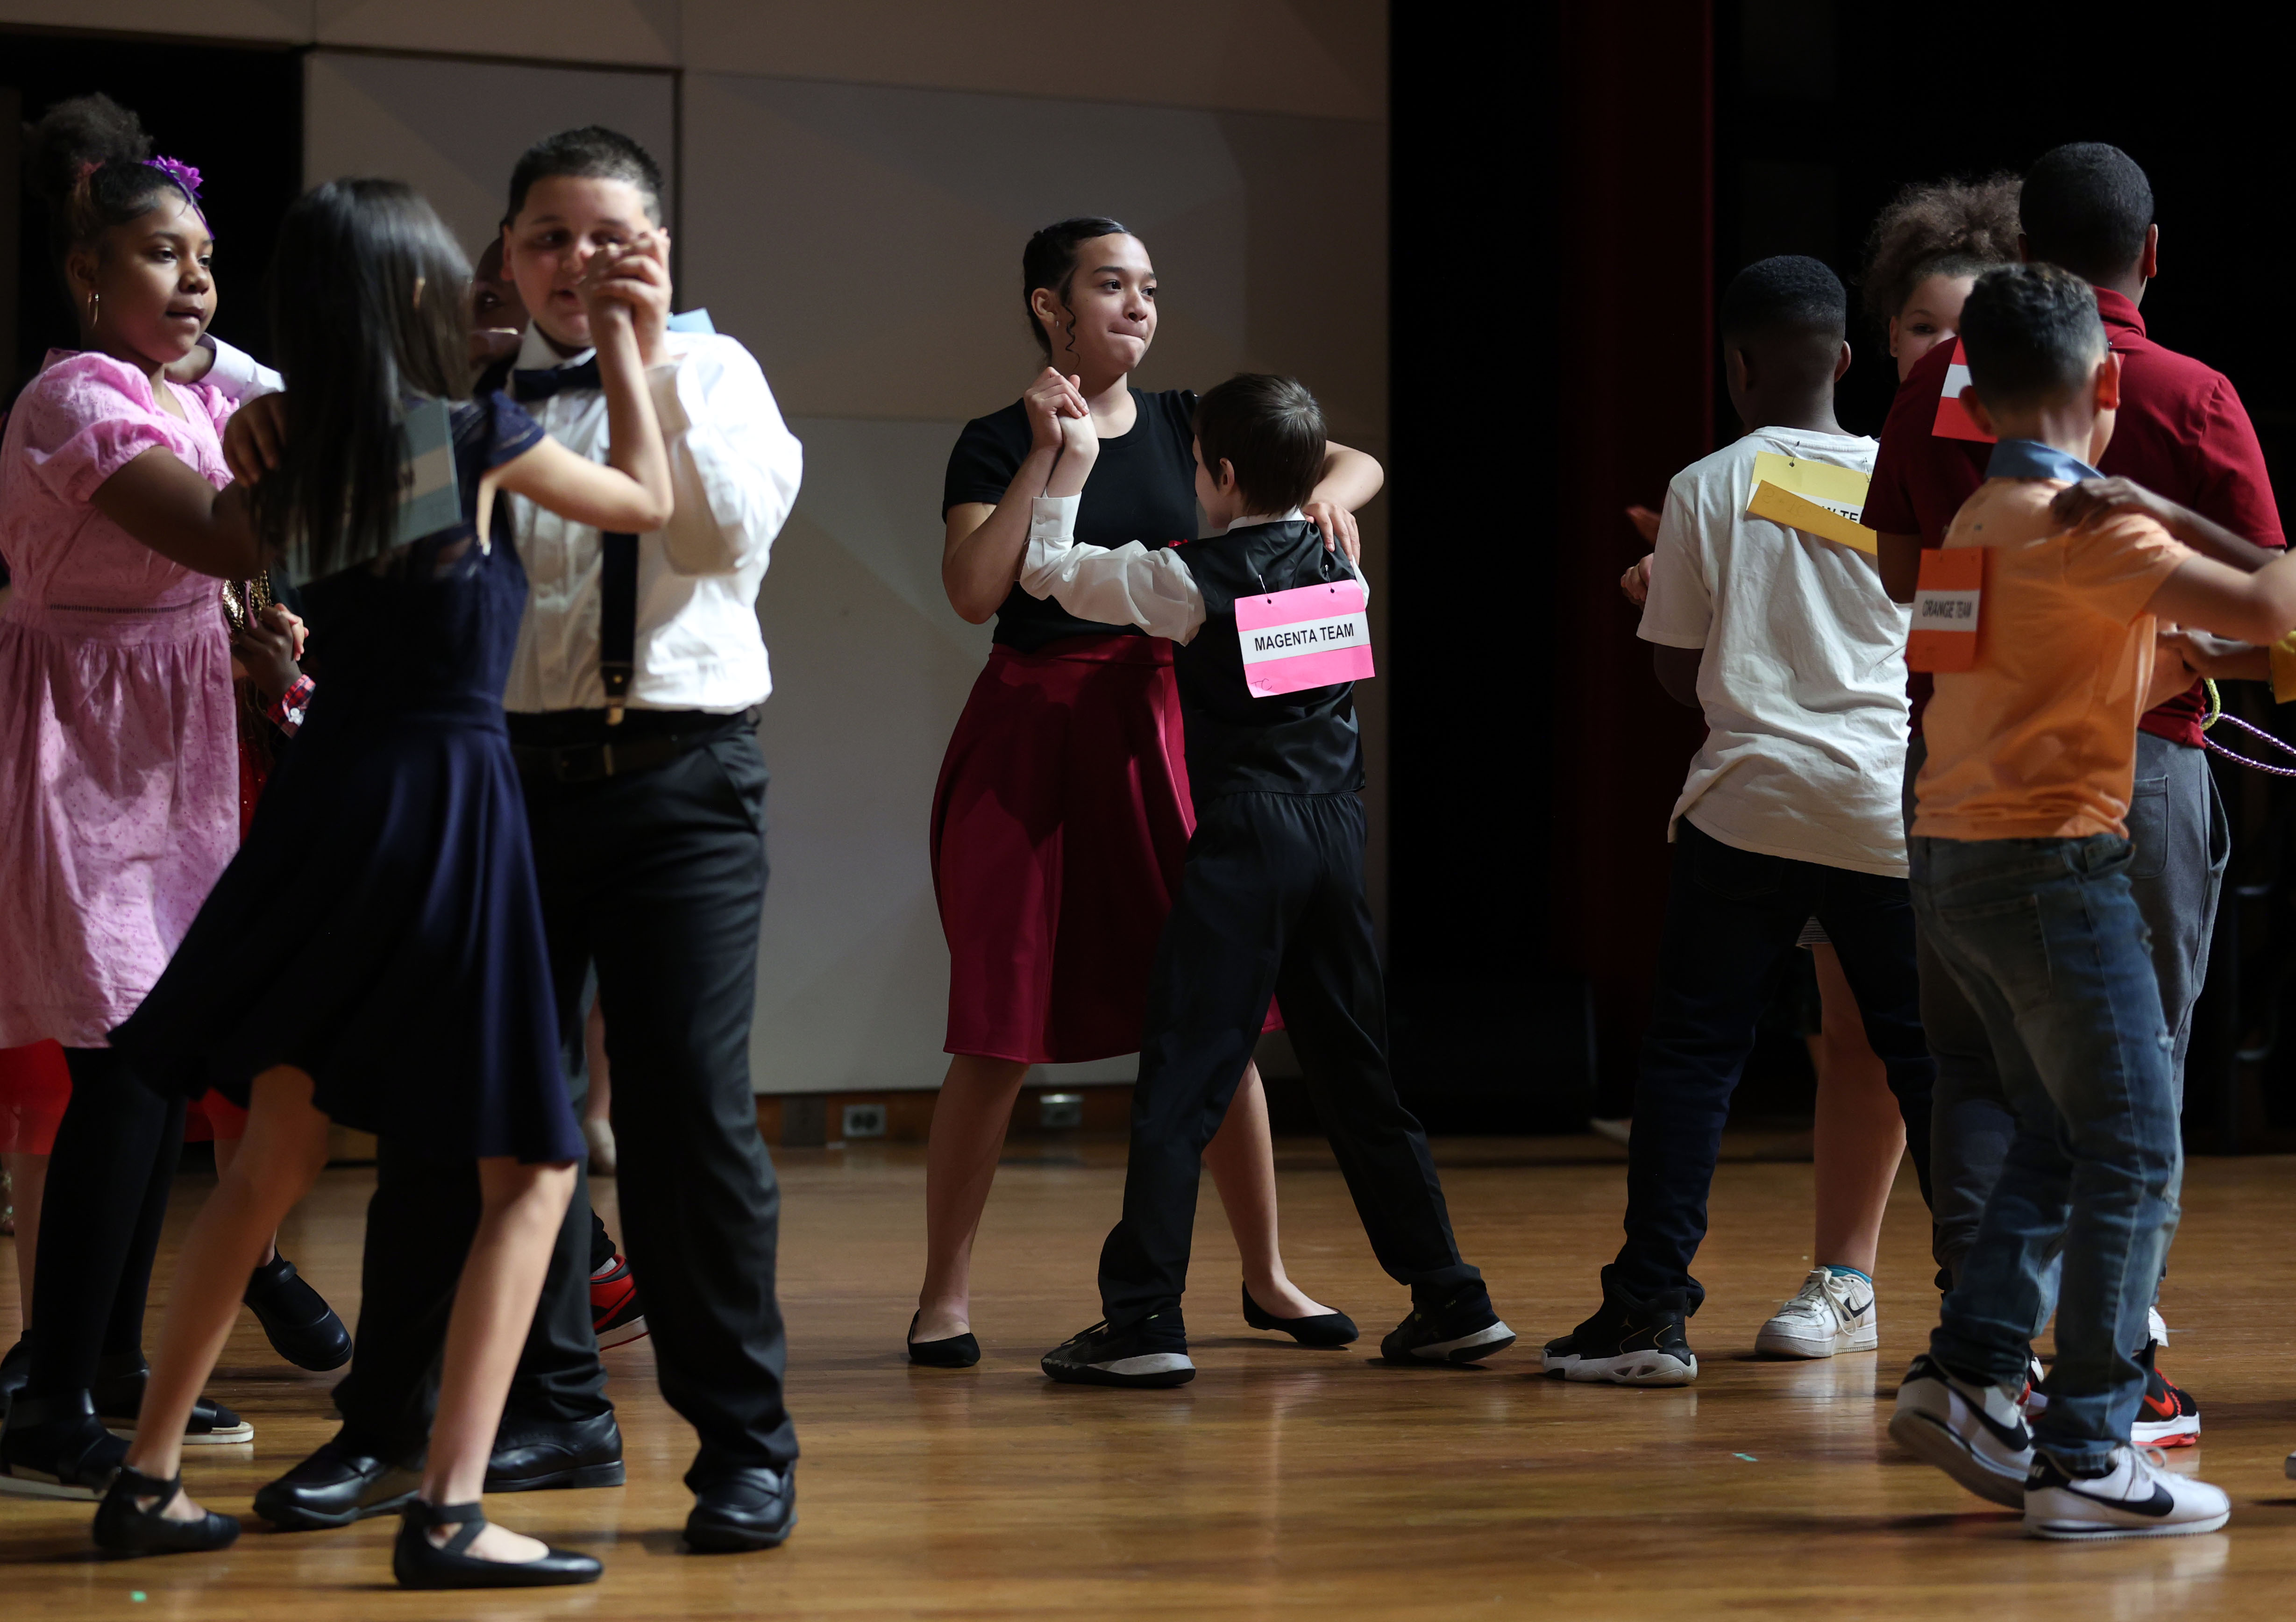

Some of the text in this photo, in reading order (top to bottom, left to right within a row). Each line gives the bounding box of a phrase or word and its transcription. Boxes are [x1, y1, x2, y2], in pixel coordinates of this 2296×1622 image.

[1840, 510, 1859, 521] TE
[1922, 600, 1954, 618] ORANGE
[1255, 623, 1354, 651] MAGENTA TEAM
